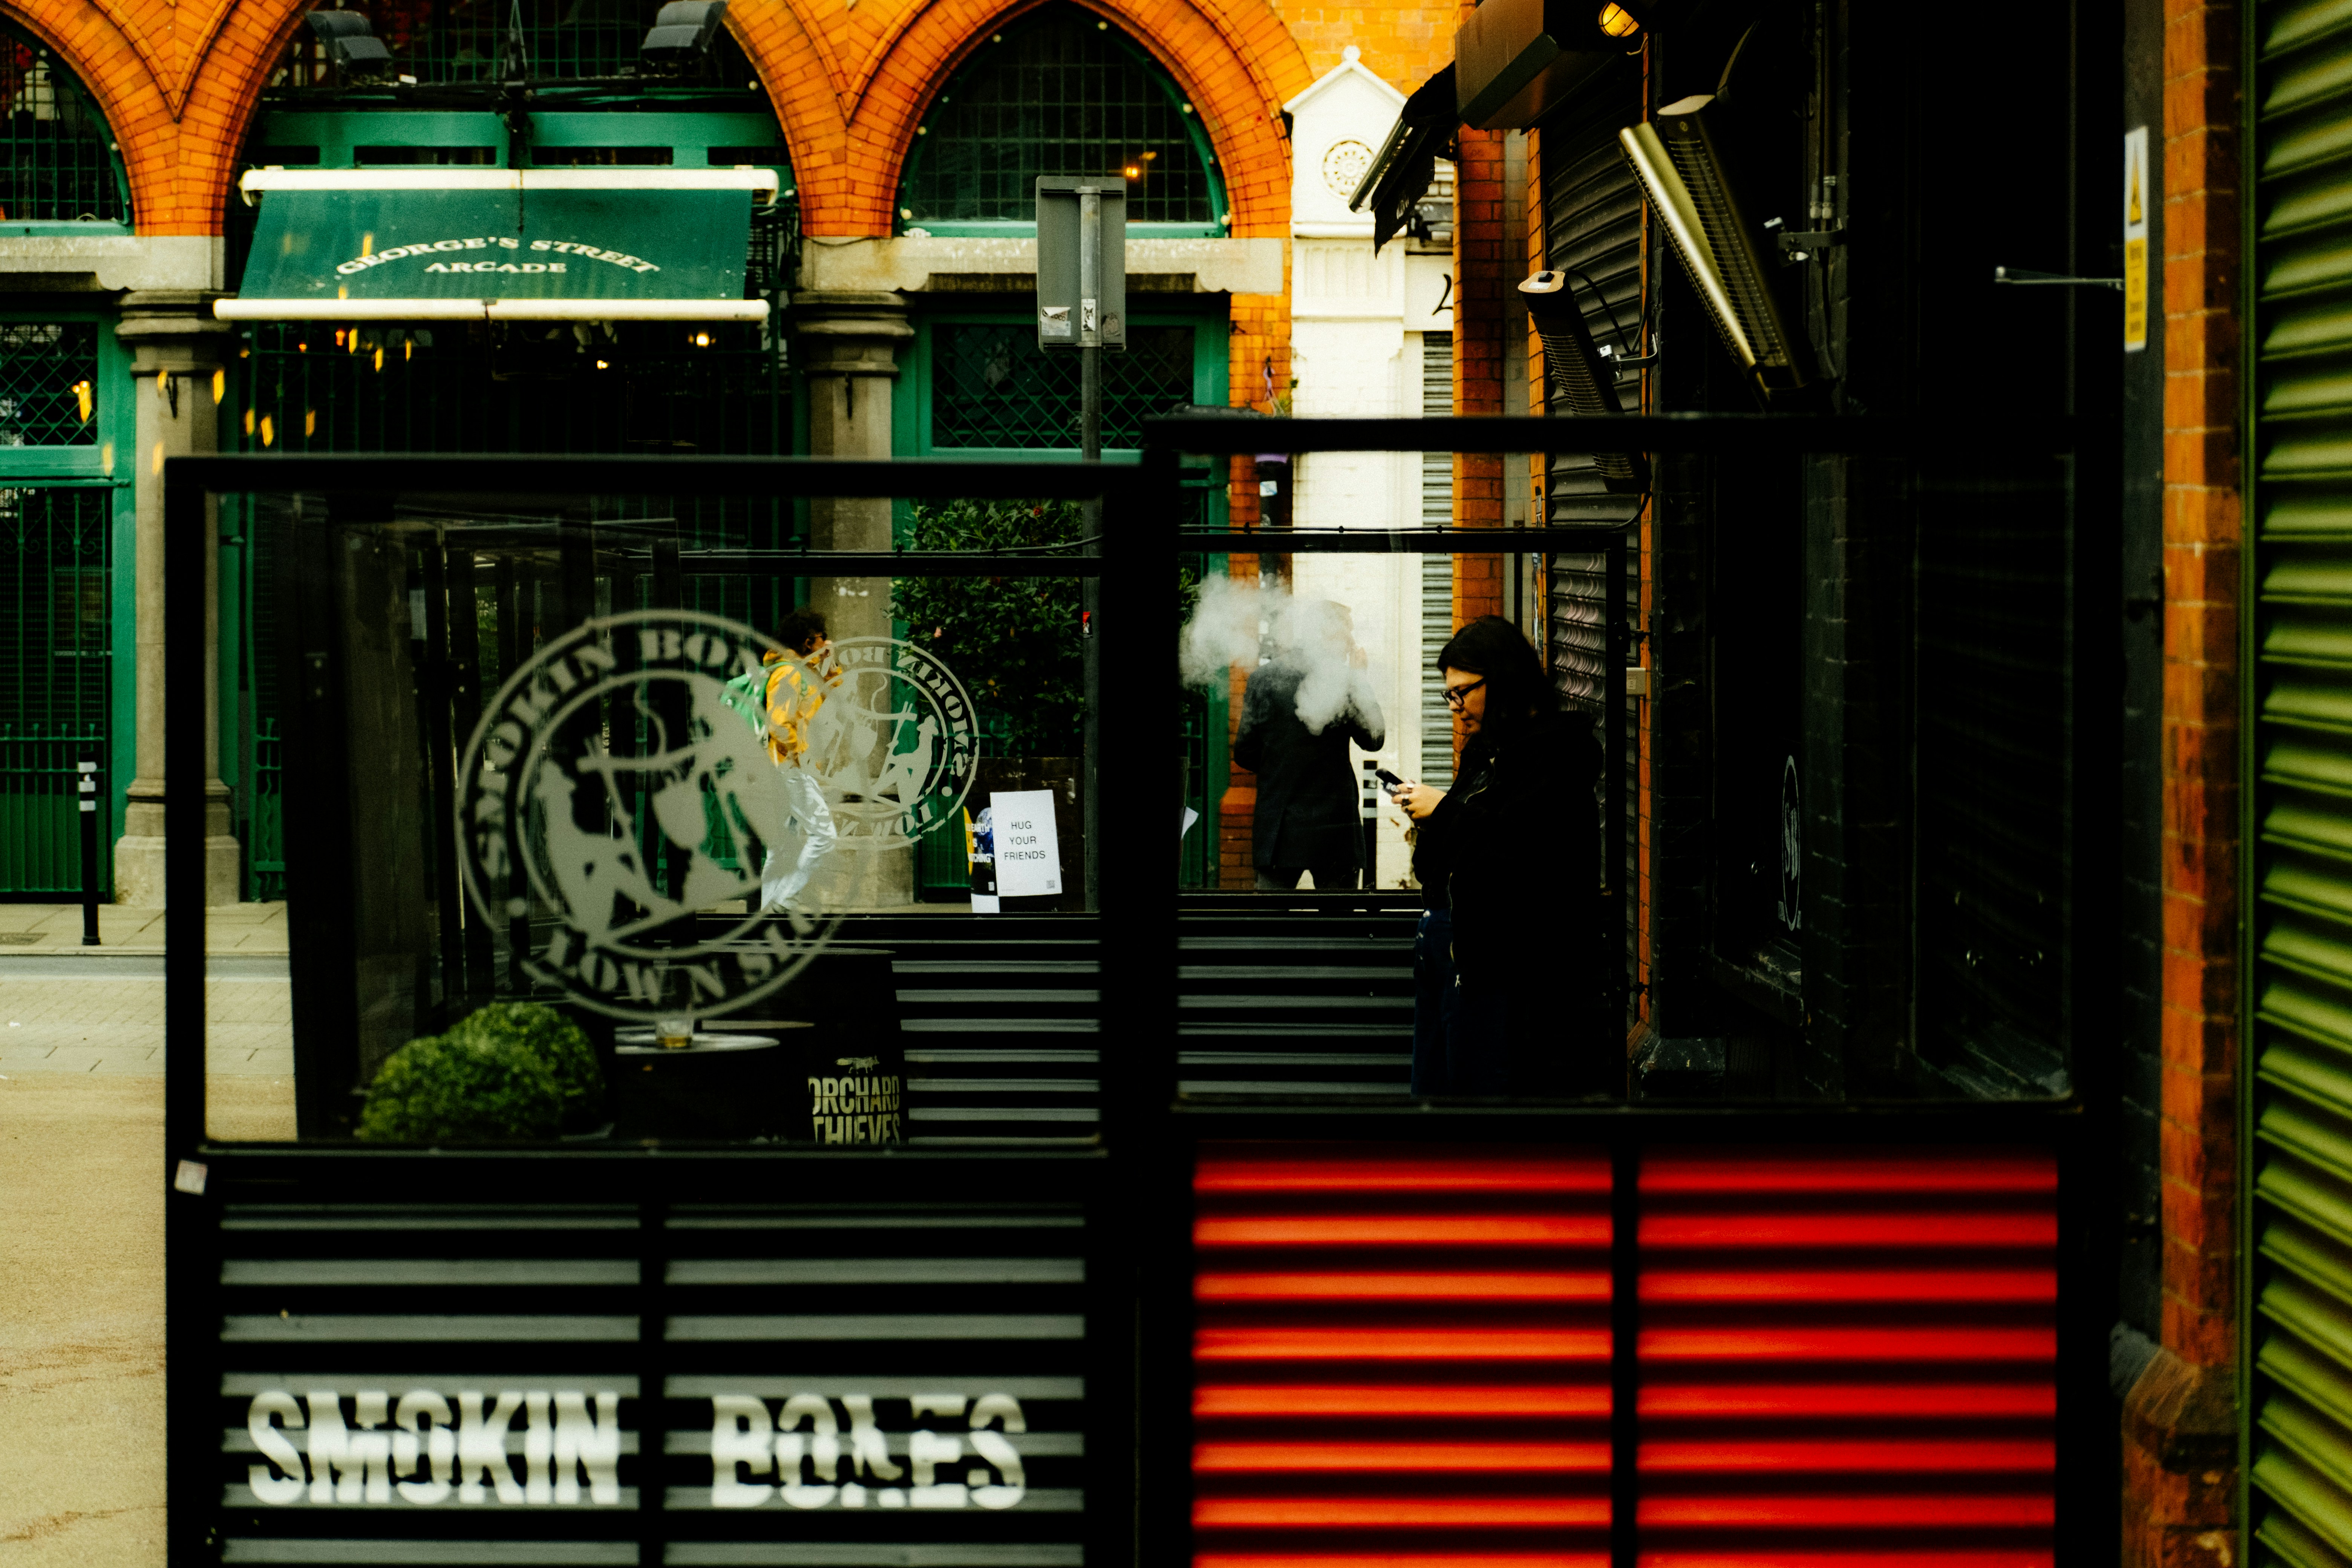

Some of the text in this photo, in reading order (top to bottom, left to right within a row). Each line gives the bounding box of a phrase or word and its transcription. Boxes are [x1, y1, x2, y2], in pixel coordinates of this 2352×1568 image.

[337, 236, 660, 274] GEORGE'S STREET
[424, 261, 567, 273] ARCADE
[475, 636, 617, 879] SMOKIN
[1009, 836, 1037, 845] YOUR
[1011, 821, 1032, 830] HUG
[1004, 850, 1046, 861] FRIENDS
[808, 1075, 900, 1115] ORCHARD
[813, 1112, 900, 1145] THIEVES
[248, 1390, 1027, 1509] SMOKIN BONES
